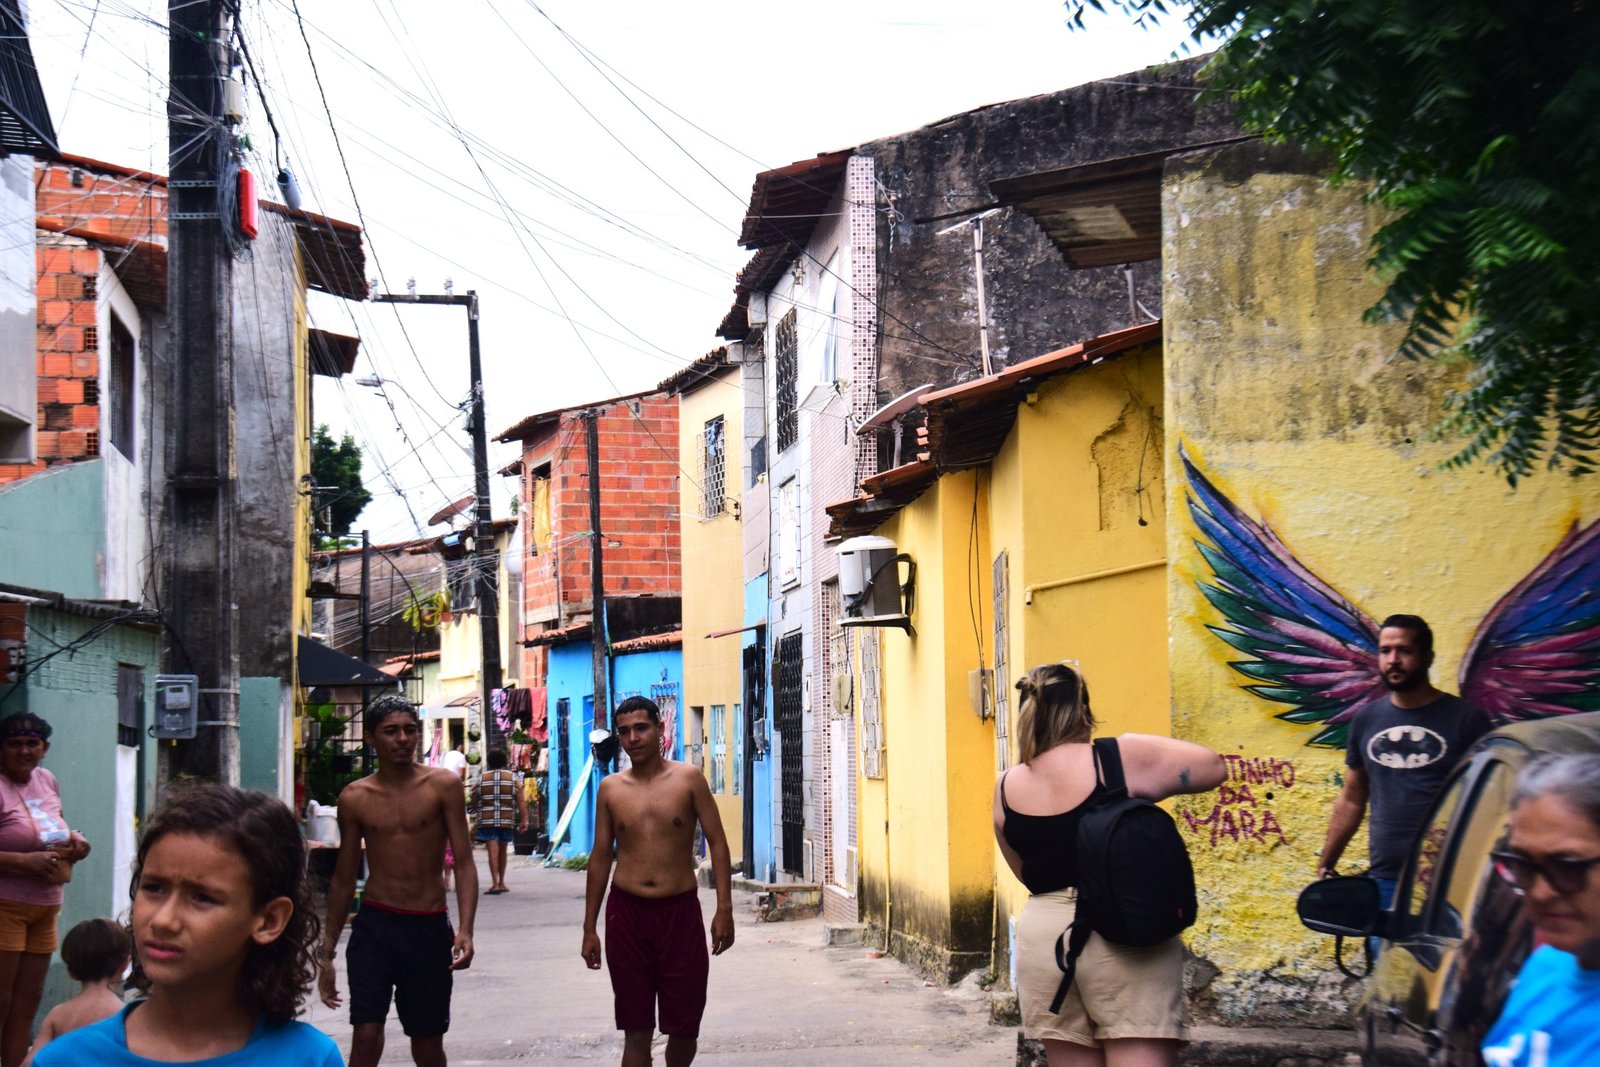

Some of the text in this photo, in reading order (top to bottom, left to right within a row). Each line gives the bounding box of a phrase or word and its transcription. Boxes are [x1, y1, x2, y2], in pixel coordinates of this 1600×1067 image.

[1219, 755, 1295, 787] TINHO
[1219, 785, 1257, 807] DA
[1183, 806, 1289, 847] MARA
